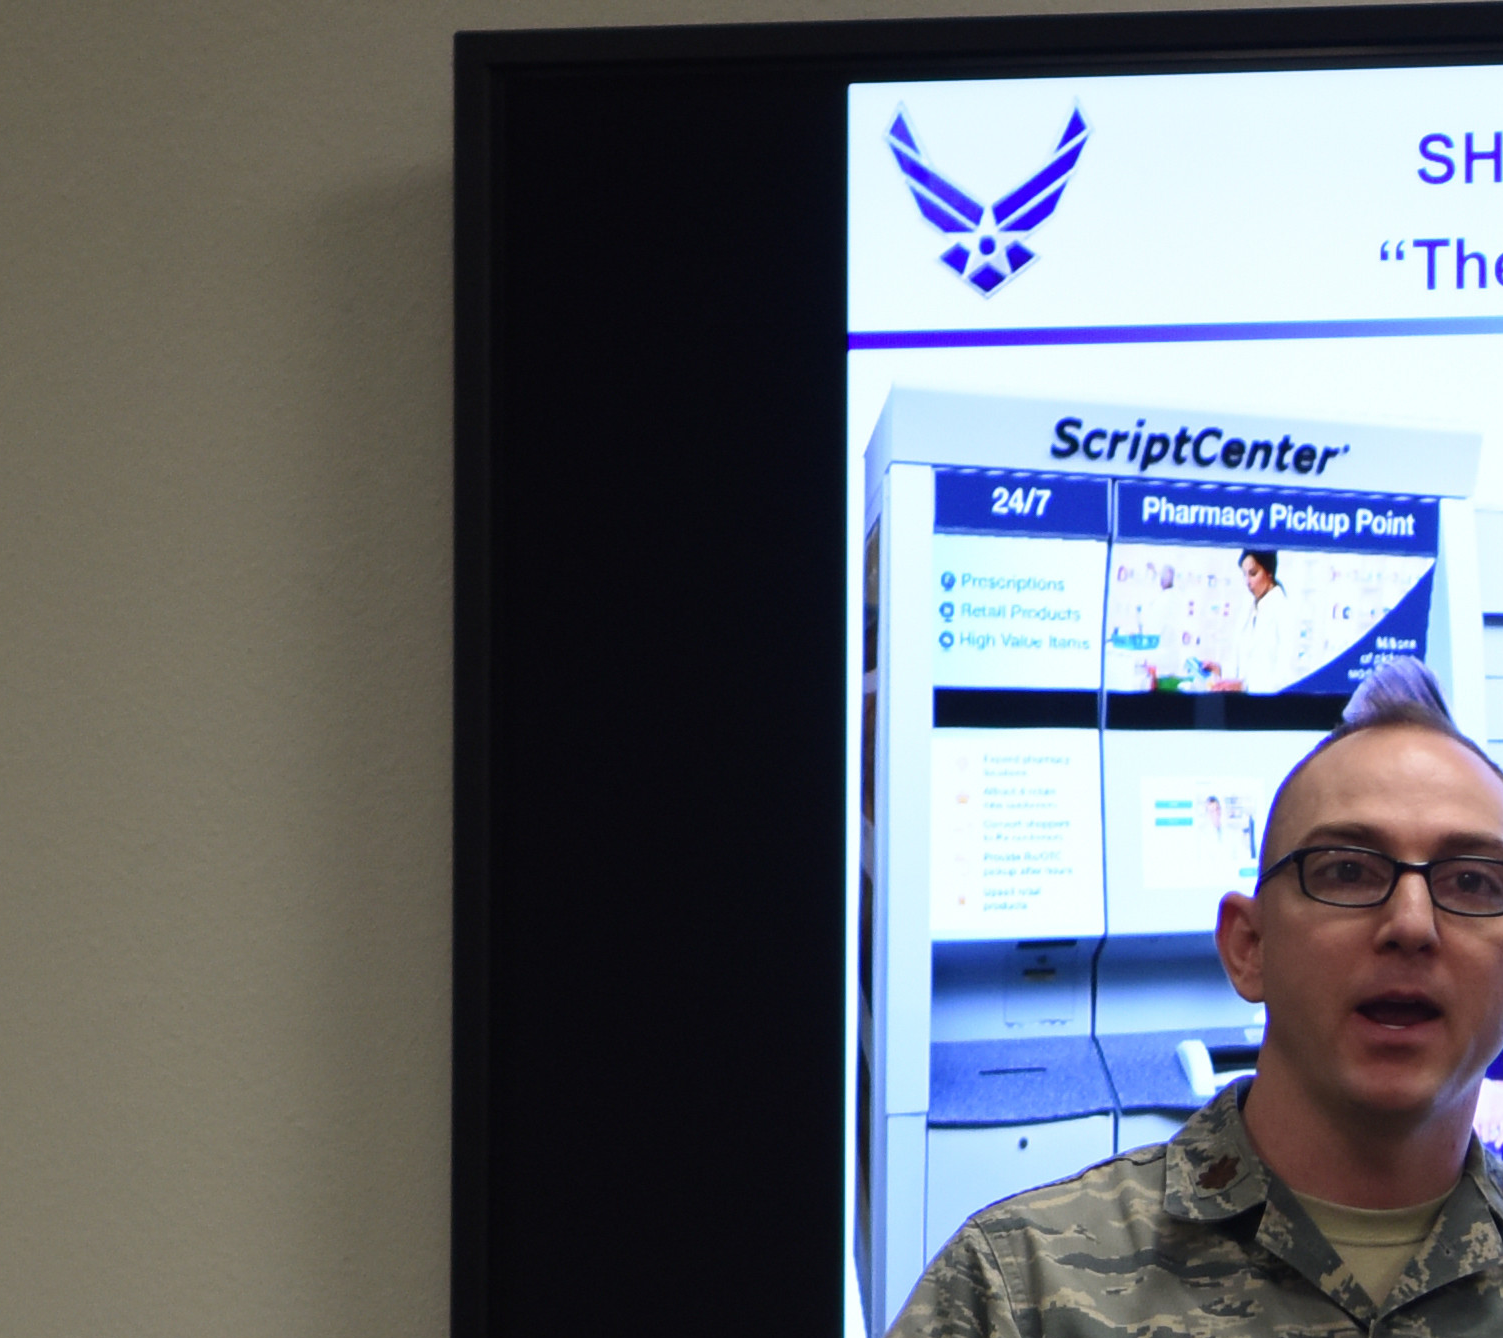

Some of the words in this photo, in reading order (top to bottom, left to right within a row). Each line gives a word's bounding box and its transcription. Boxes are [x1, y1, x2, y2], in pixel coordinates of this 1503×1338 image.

[1049, 418, 1340, 475] ScriptCenter
[993, 488, 1051, 515] 24/7
[1144, 497, 1263, 533] Pharmacy
[1271, 504, 1349, 536] Pickup
[1357, 509, 1414, 535] Point
[961, 573, 1064, 592] Prescriptions
[961, 603, 1006, 618] Retail
[1011, 604, 1080, 620] Products
[960, 632, 996, 651] High
[1001, 634, 1041, 648] Value
[1049, 637, 1089, 649] Items
